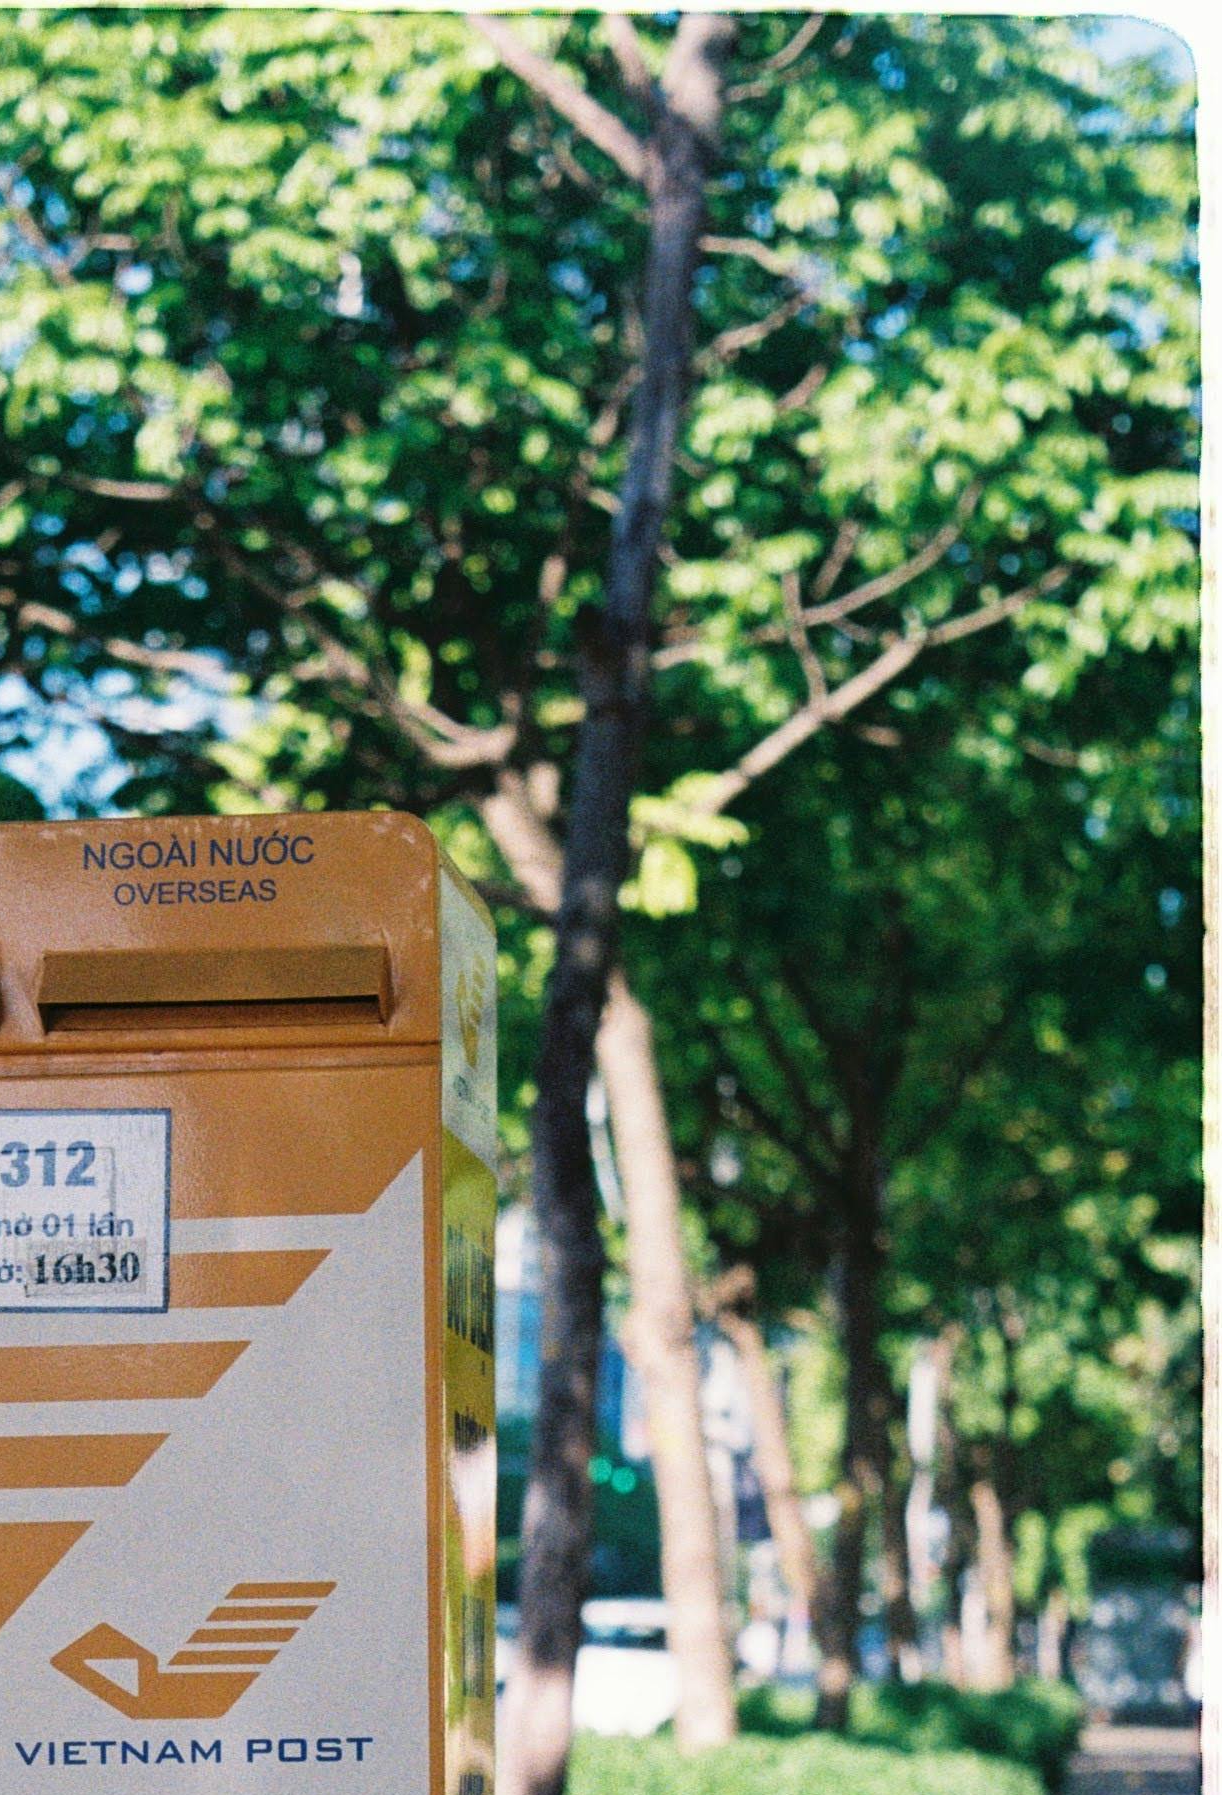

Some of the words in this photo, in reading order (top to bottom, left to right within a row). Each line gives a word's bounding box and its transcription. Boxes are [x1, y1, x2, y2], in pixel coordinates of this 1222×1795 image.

[82, 837, 198, 870] NGOÀI
[209, 830, 316, 867] NƯỚC
[114, 878, 278, 907] OVERSEAS
[41, 1212, 75, 1238] 01
[34, 1250, 141, 1285] 16h30
[14, 1739, 223, 1766] VIETNAM
[246, 1737, 374, 1764] POST
